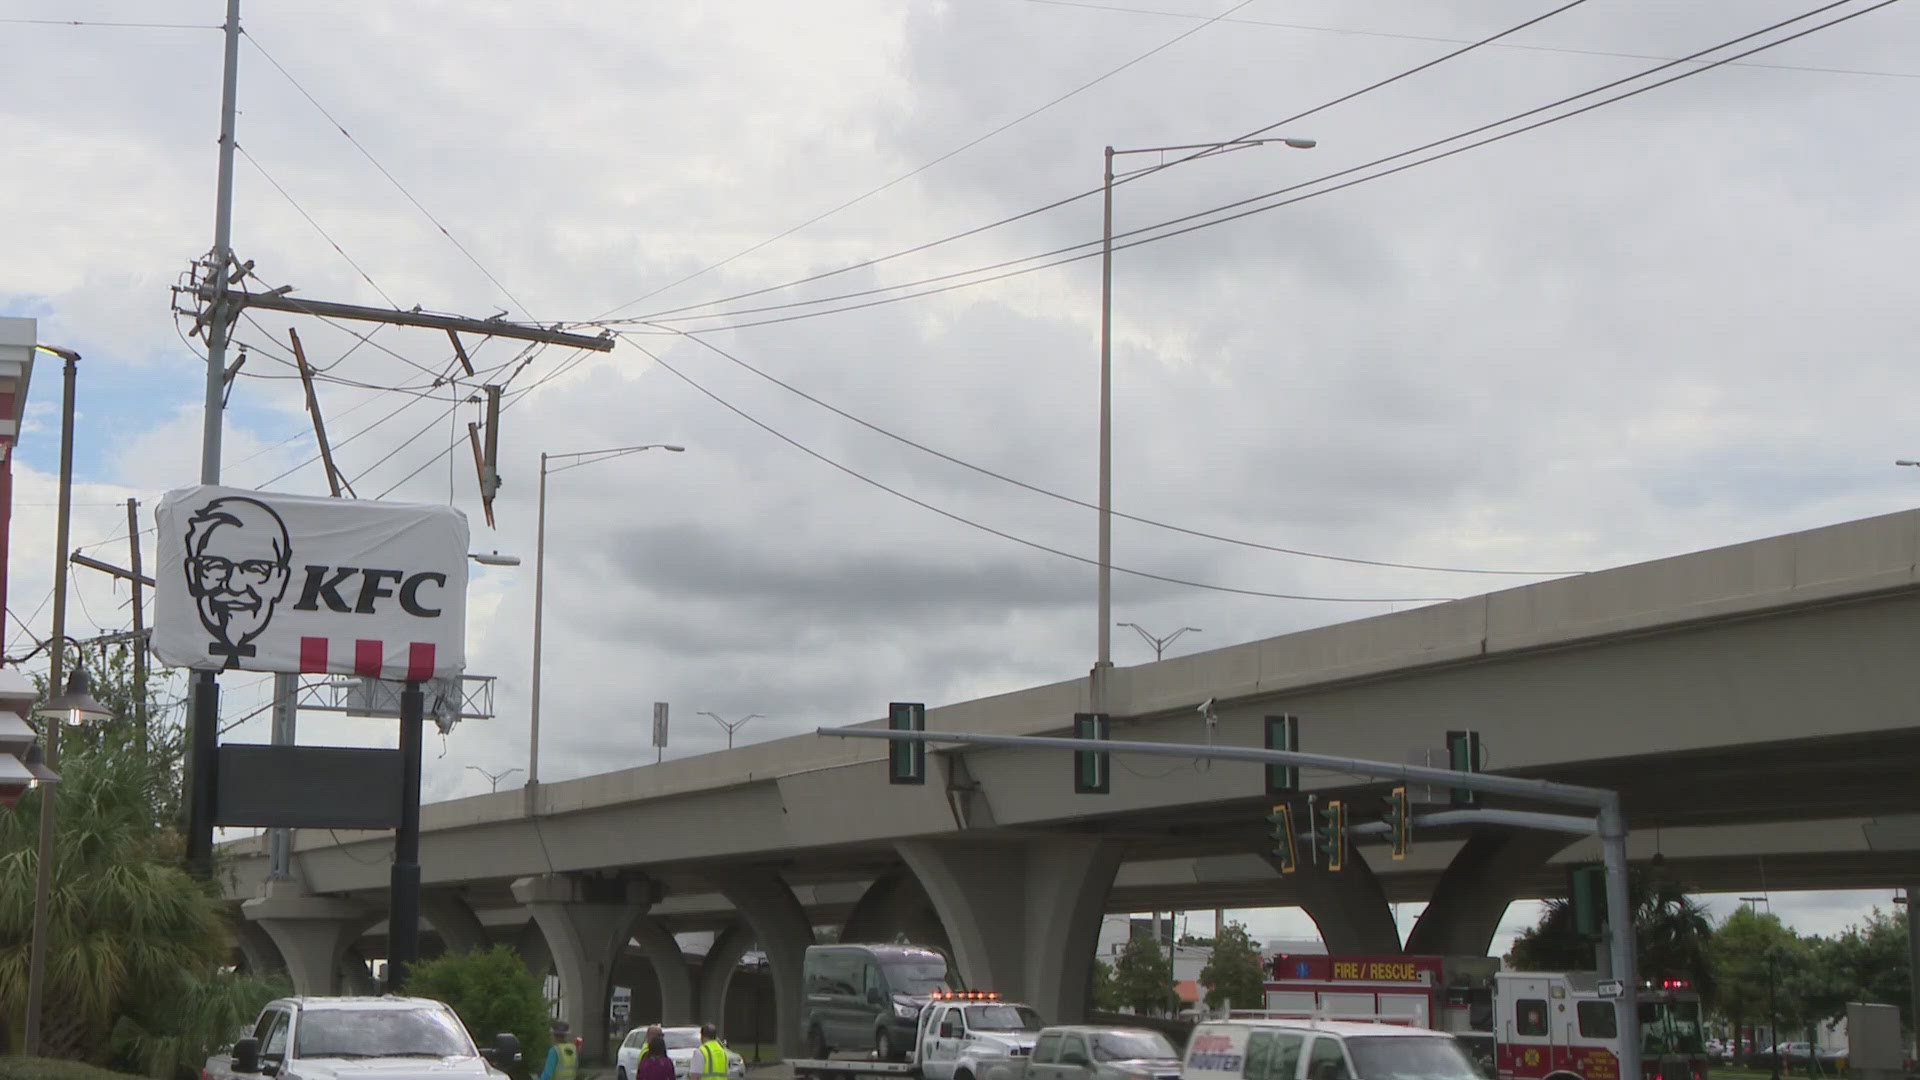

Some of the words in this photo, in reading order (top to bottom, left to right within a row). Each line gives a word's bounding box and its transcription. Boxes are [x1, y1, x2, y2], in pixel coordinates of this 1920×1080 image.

[293, 564, 447, 618] KFC
[1333, 961, 1359, 979] FIRE
[1369, 962, 1416, 980] RESCUE
